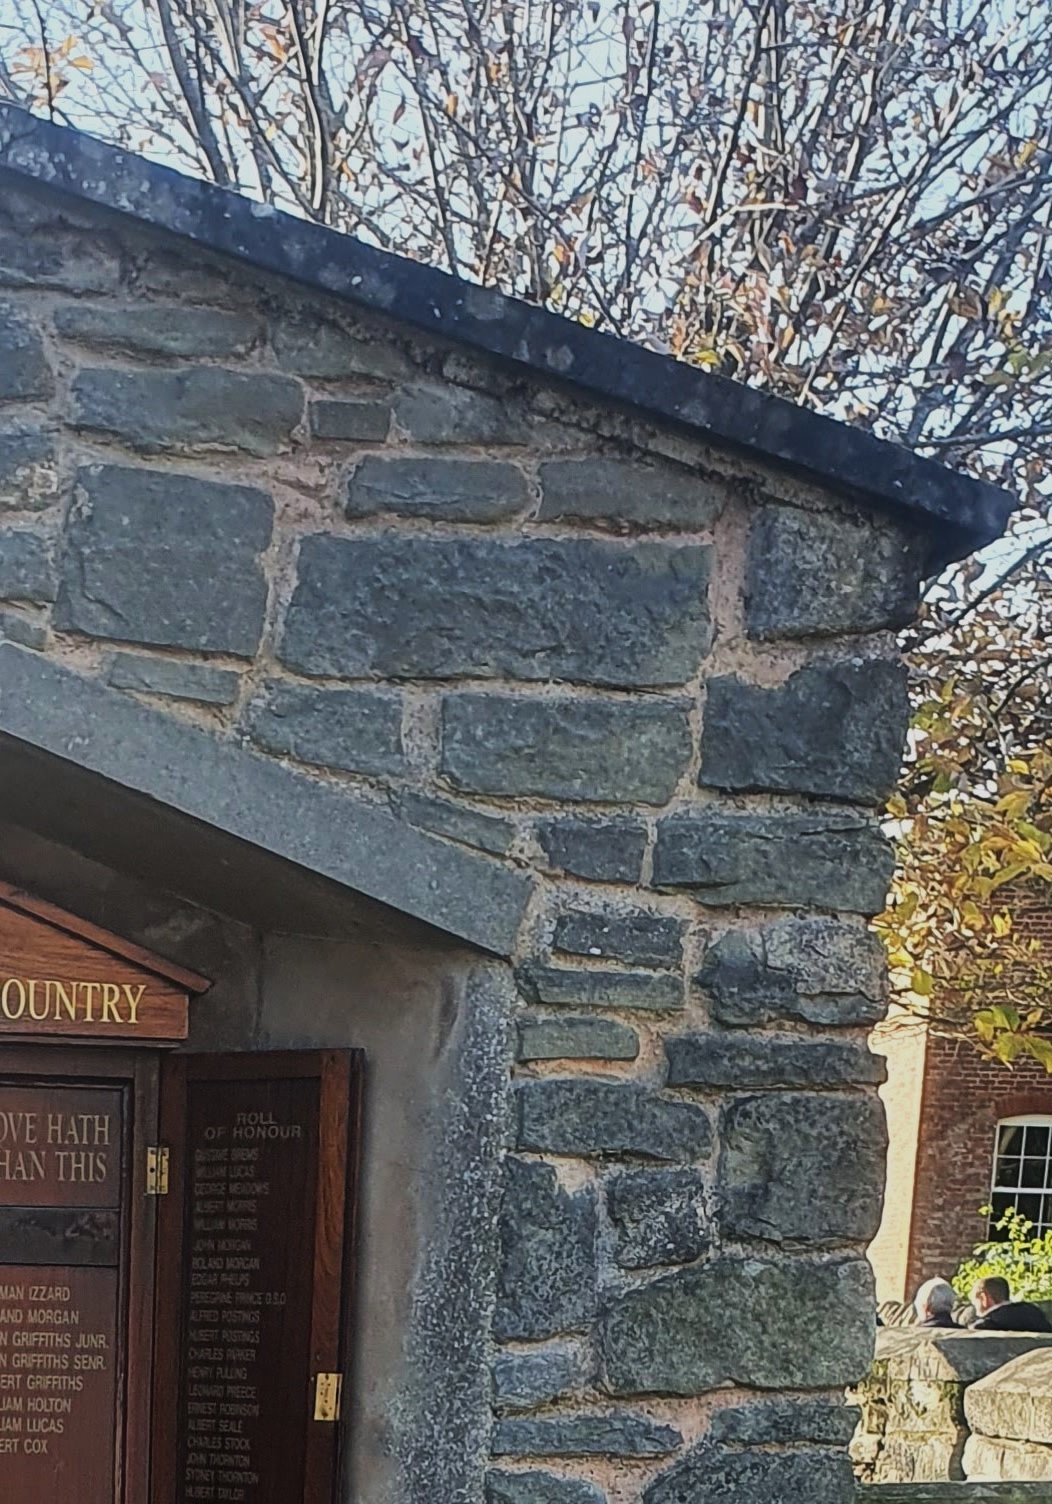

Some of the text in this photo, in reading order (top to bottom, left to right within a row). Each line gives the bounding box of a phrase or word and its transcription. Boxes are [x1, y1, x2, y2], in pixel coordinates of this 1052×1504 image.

[237, 1113, 278, 1125] ROLL
[47, 1113, 110, 1146] HATH
[205, 1125, 301, 1139] OF HONOUR
[55, 1151, 108, 1183] THIS
[29, 1286, 70, 1302] IZZARD
[28, 1309, 80, 1325] MORGAN
[12, 1332, 71, 1348] GRIFFITHS
[12, 1353, 69, 1369] GRIFFITHS
[26, 1375, 84, 1392] GRIFFITHS
[27, 1396, 72, 1412] HOLTON
[26, 1419, 64, 1434] LUCAS
[24, 1440, 48, 1455] COX
